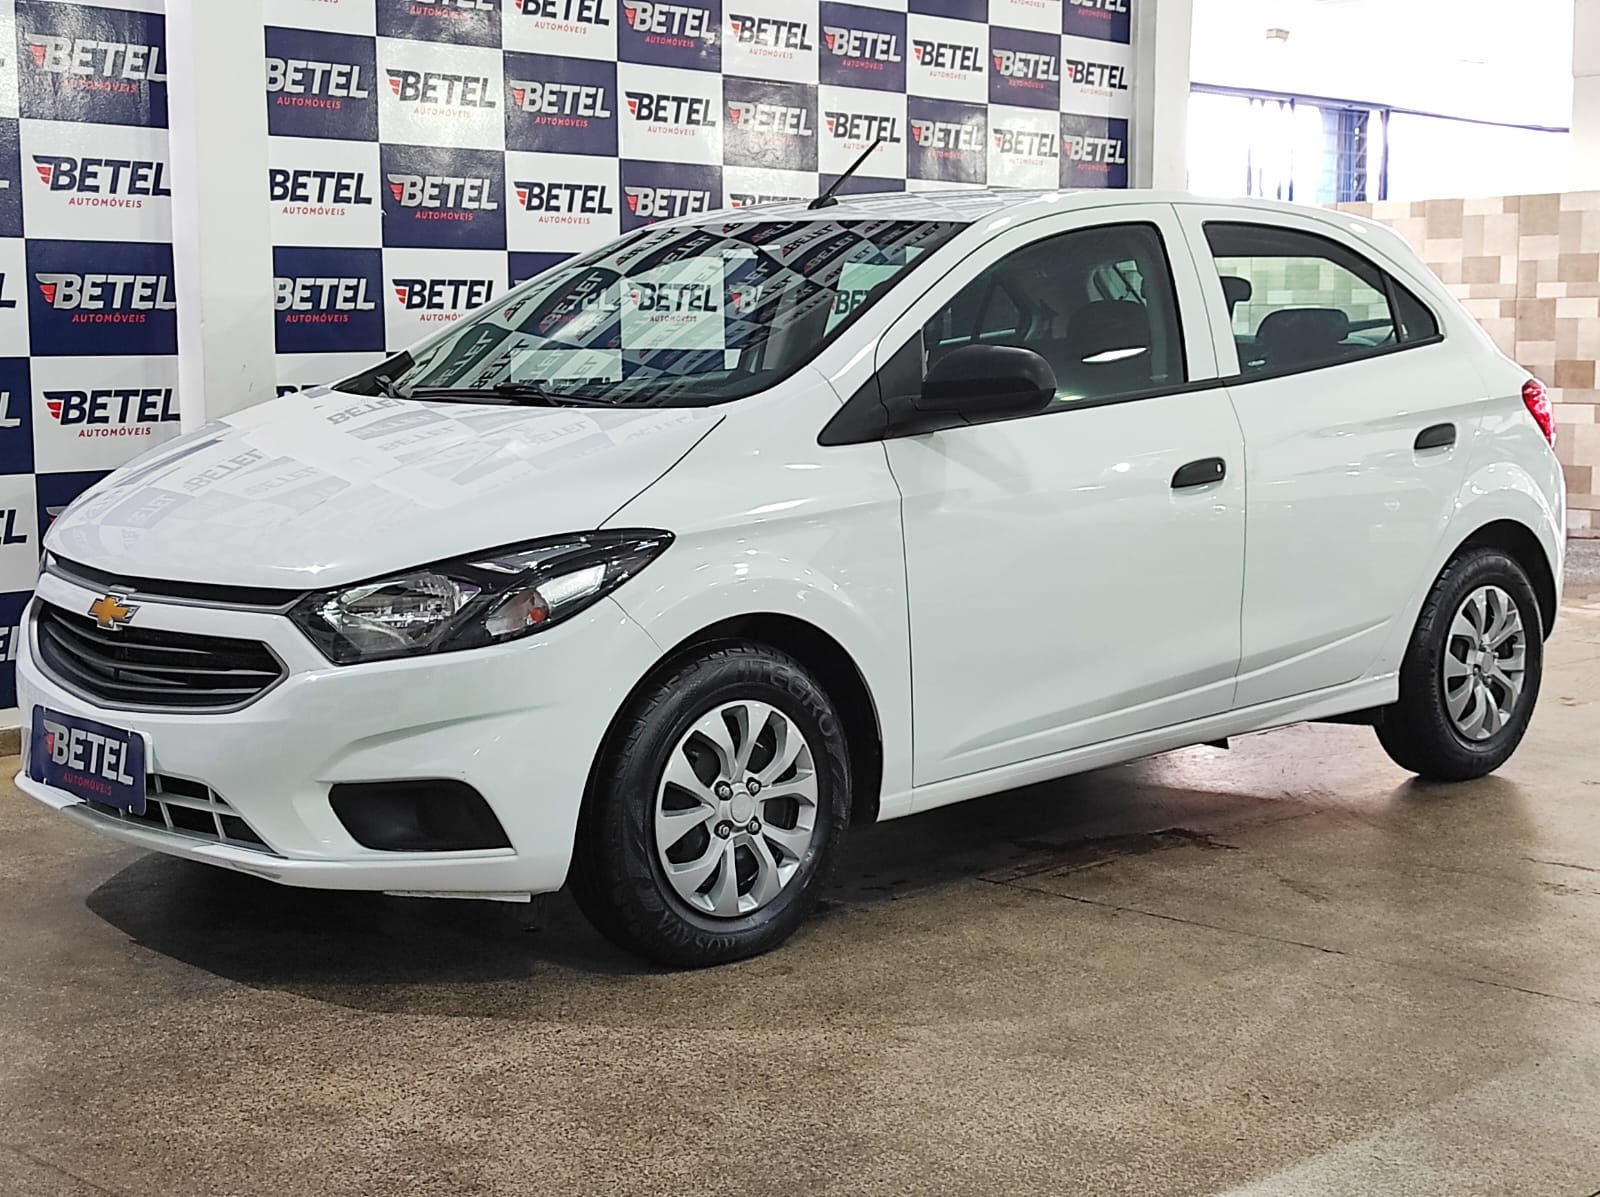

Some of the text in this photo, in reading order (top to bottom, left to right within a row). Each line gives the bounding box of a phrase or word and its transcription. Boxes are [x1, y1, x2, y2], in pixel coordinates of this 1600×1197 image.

[534, 21, 588, 35] AUTOMÓVEIS
[622, 0, 716, 39] BETEL
[729, 13, 813, 52] BETEL
[27, 33, 167, 82] BETEL
[645, 35, 695, 48] AUTOMÓVEIS
[823, 25, 902, 63] BETEL
[912, 39, 984, 73] BETEL
[265, 57, 369, 99] BETEL
[992, 49, 1060, 82] BETEL
[1065, 58, 1128, 90] BETEL
[277, 97, 342, 109] AUTOMÓVEIS
[386, 69, 497, 109] BETEL
[510, 79, 611, 119] BETEL
[535, 116, 588, 128] AUTOMÓVEIS
[625, 91, 717, 127] BETEL
[728, 100, 813, 137] BETEL
[647, 125, 696, 137] AUTOMÓVEIS
[824, 111, 902, 143] BETEL
[910, 119, 984, 151] BETEL
[993, 128, 1059, 158] BETEL
[1063, 134, 1126, 165] BETEL
[33, 154, 171, 197] BETEL
[269, 168, 373, 205] BETEL
[387, 173, 499, 211] BETEL
[69, 197, 143, 209] AUTOMÓVEIS
[282, 206, 346, 216] AUTOMÓVEIS
[514, 181, 613, 214] BETEL
[415, 211, 474, 221] AUTOMÓVEIS
[538, 215, 591, 225] AUTOMÓVEIS
[36, 273, 177, 311] BETEL
[273, 277, 376, 311] BETEL
[72, 312, 146, 324] AUTOMÓVEIS
[285, 313, 349, 323] AUTOMÓVEIS
[43, 388, 181, 425] BETEL
[79, 427, 152, 438] AUTOMÓVEIS
[43, 719, 134, 786] BETEL
[63, 771, 113, 796] AUTOMÓVEIS
